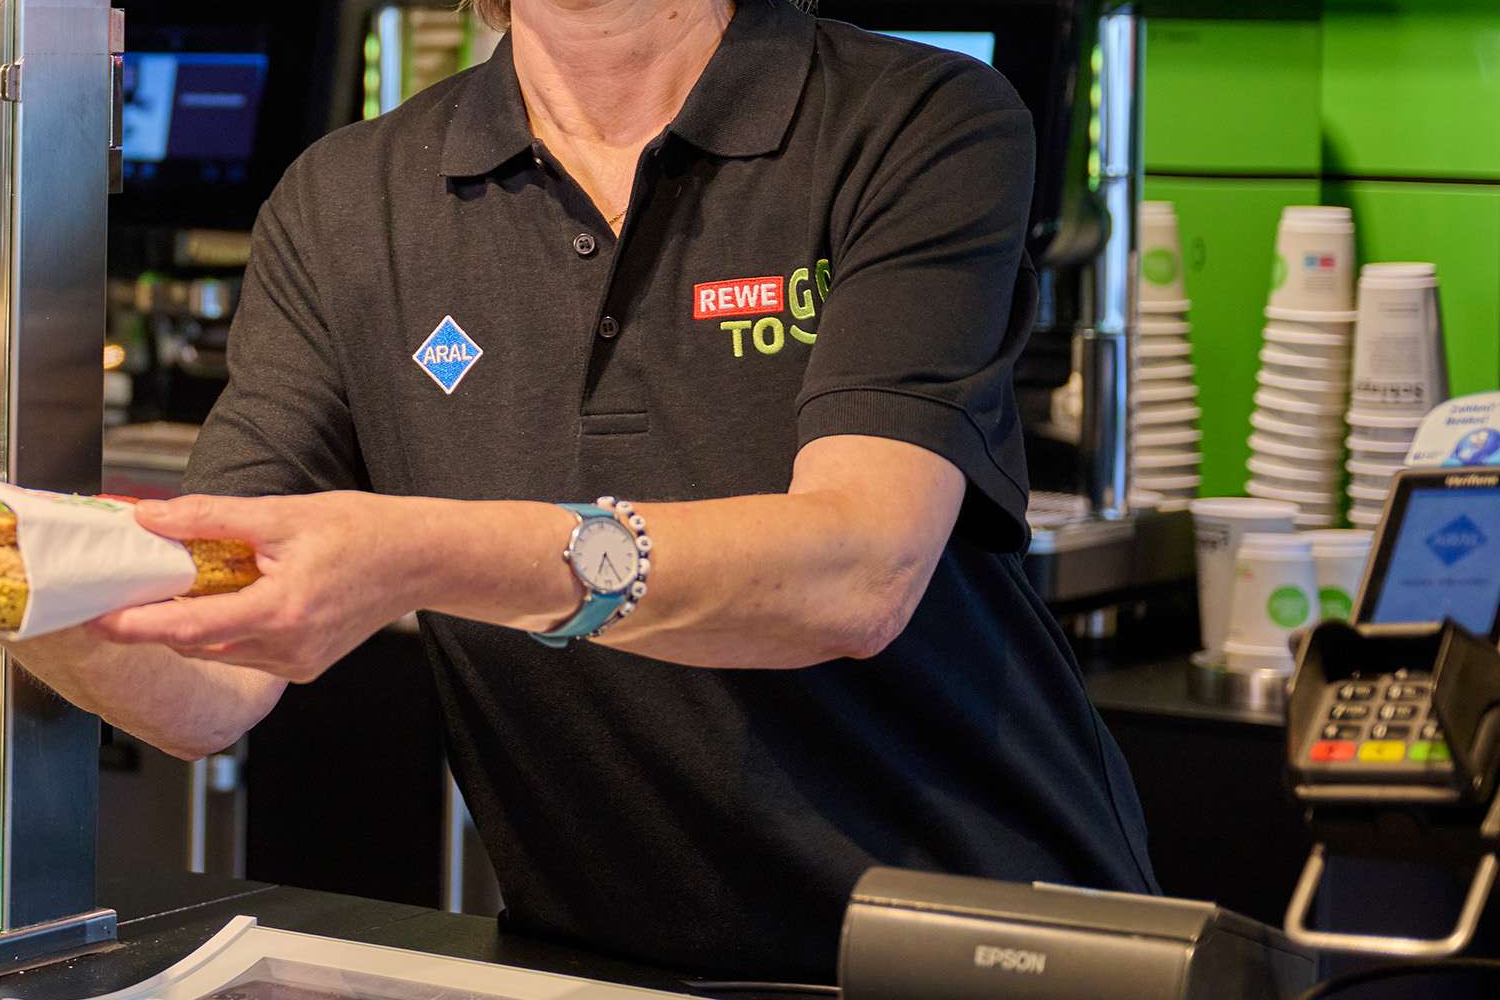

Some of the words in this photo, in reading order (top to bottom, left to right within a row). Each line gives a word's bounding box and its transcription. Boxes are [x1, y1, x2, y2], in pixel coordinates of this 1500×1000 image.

[700, 283, 778, 312] REWE
[721, 317, 785, 357] TO
[423, 343, 472, 365] ARAL
[974, 945, 1046, 974] EPSON
